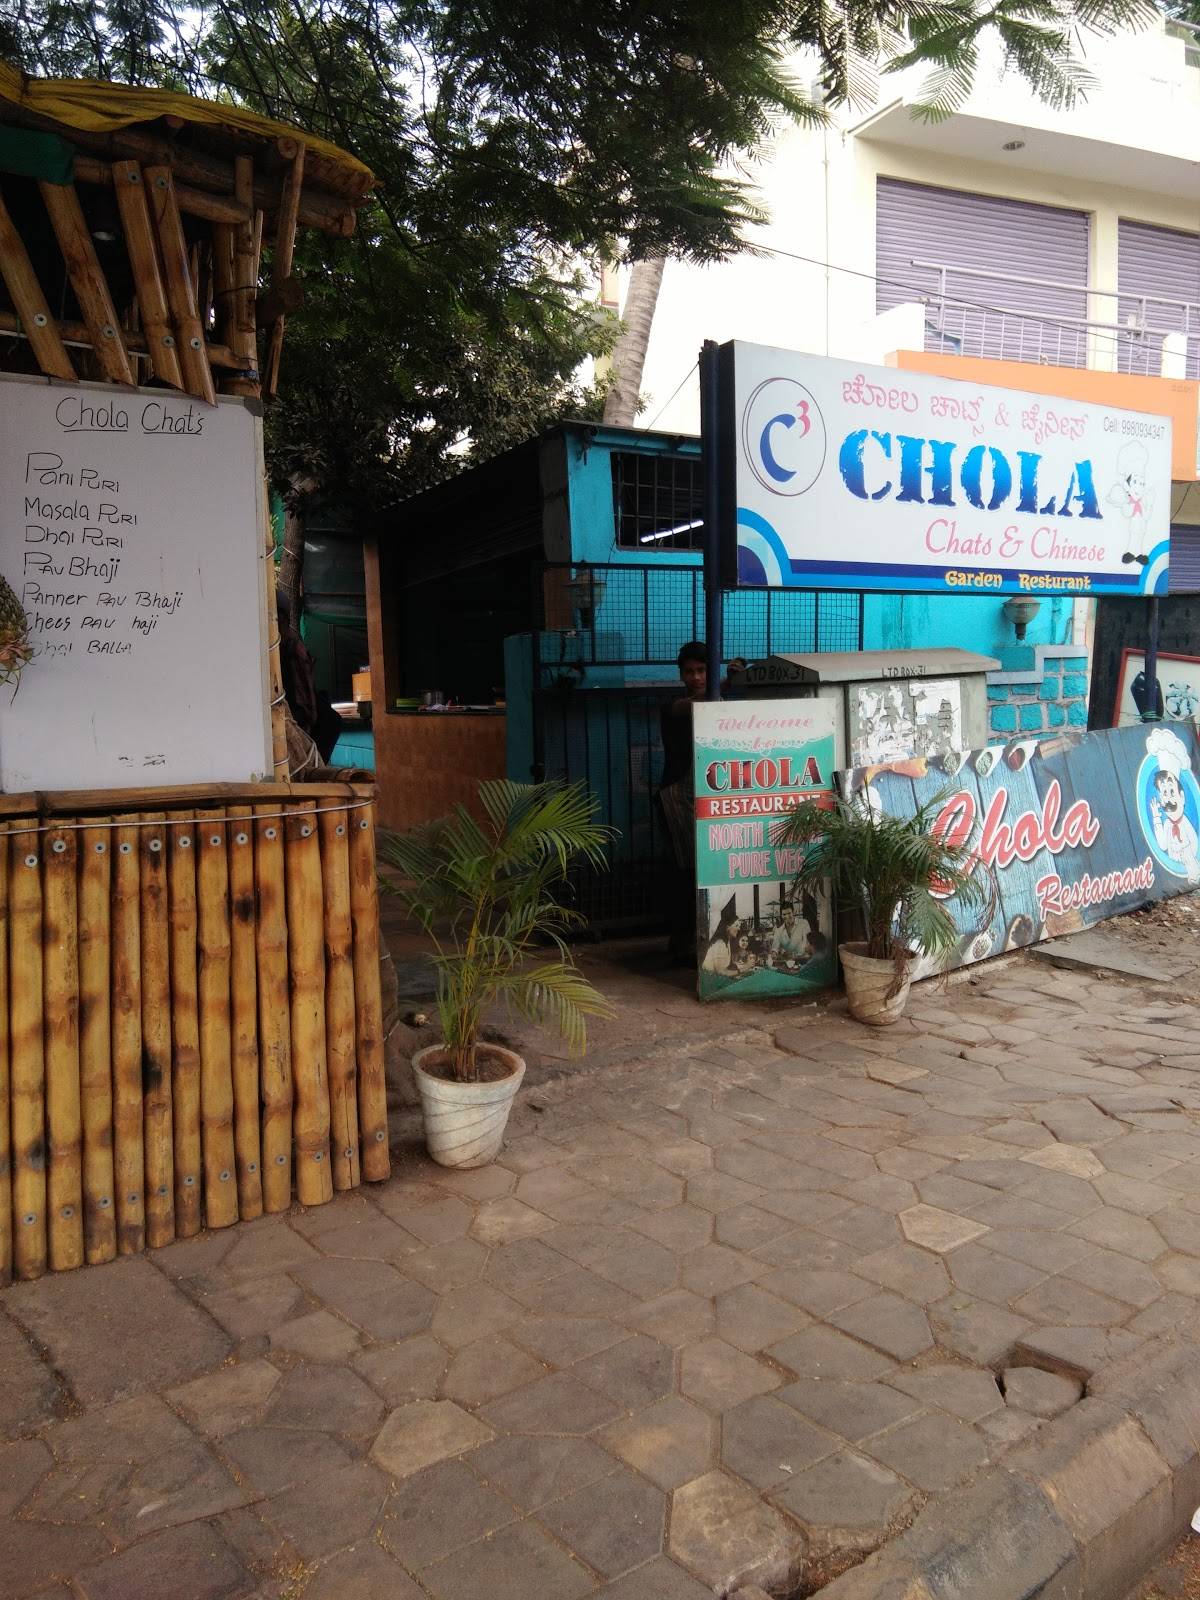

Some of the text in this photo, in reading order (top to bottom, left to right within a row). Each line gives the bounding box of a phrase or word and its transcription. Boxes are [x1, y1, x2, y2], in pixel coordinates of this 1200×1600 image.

[55, 396, 129, 429] Chola
[994, 402, 1010, 427] &
[839, 429, 1103, 519] CHOLA
[24, 496, 90, 521] Masala
[925, 518, 1105, 562] Chats & Chinese
[68, 556, 121, 584] Bhaji
[944, 570, 1092, 591] Garden Resturant
[135, 591, 184, 615] Bhaji
[705, 755, 825, 793] CHOLA
[708, 820, 764, 852] NORTH
[928, 778, 1100, 899] Chola
[728, 850, 772, 880] PURE
[1035, 856, 1155, 922] Restaurant
